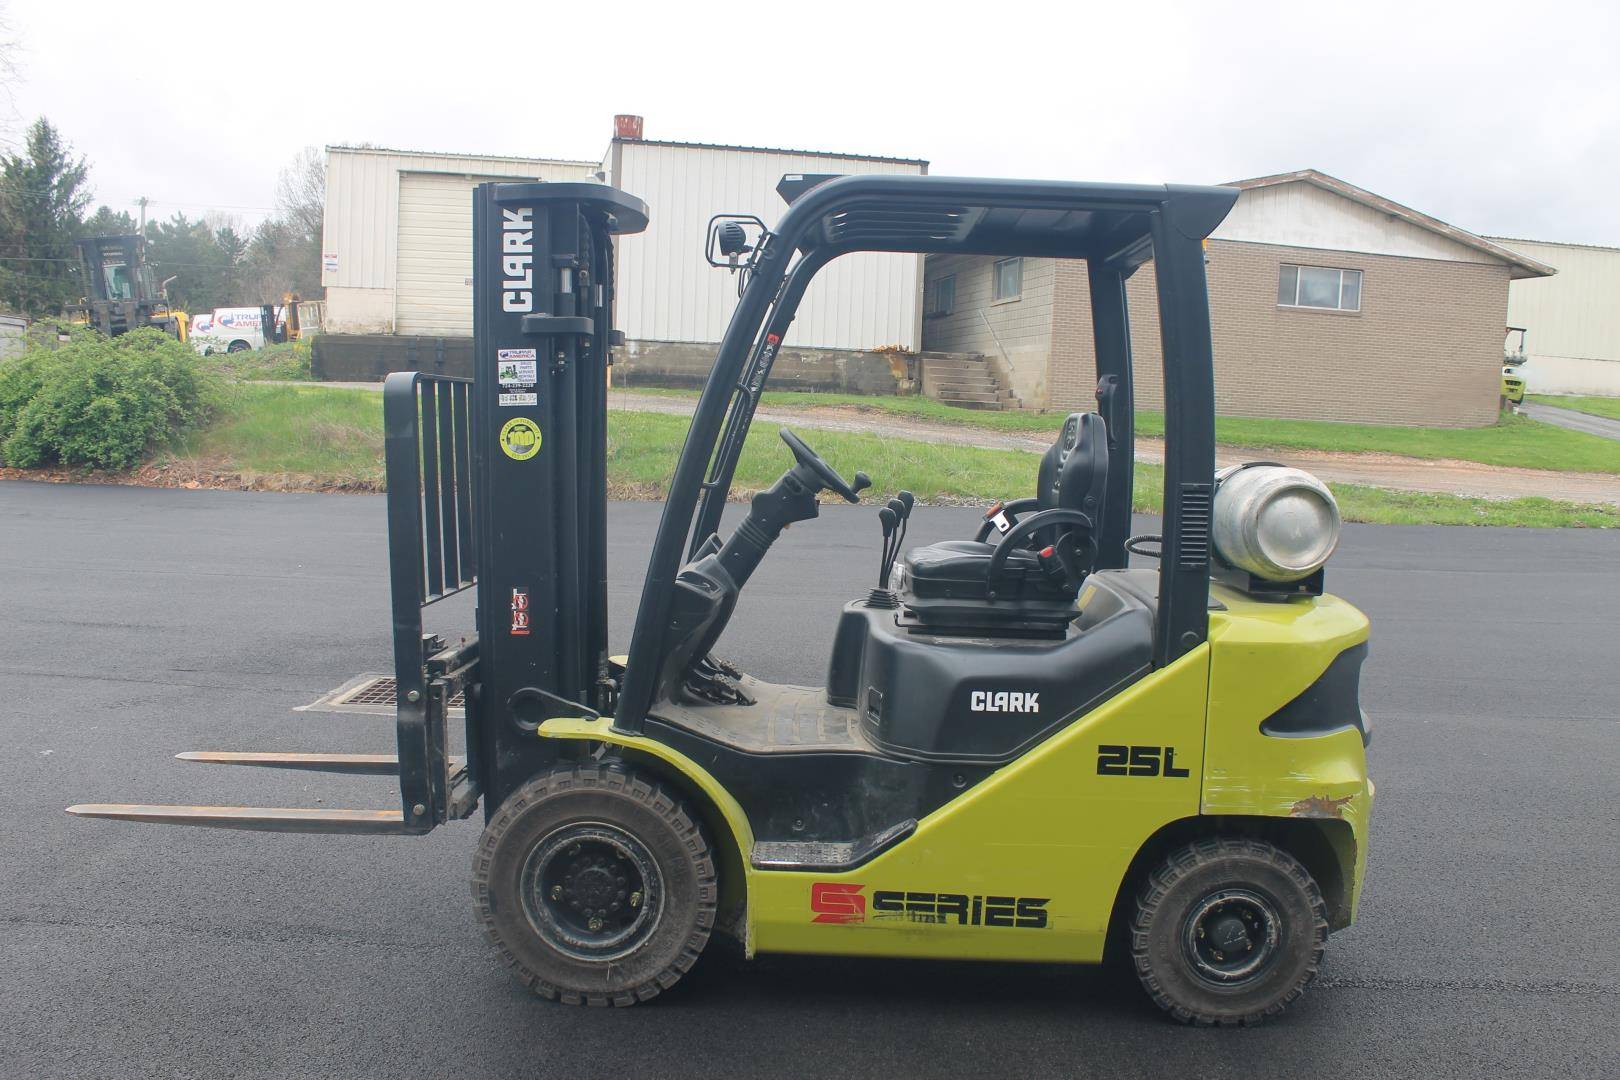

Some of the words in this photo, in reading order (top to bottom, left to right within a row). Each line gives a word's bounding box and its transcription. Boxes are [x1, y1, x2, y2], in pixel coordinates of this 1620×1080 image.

[503, 207, 533, 312] CLARK
[971, 691, 1039, 713] CLARK
[1097, 745, 1190, 778] 25L
[873, 890, 1052, 929] SERIES
